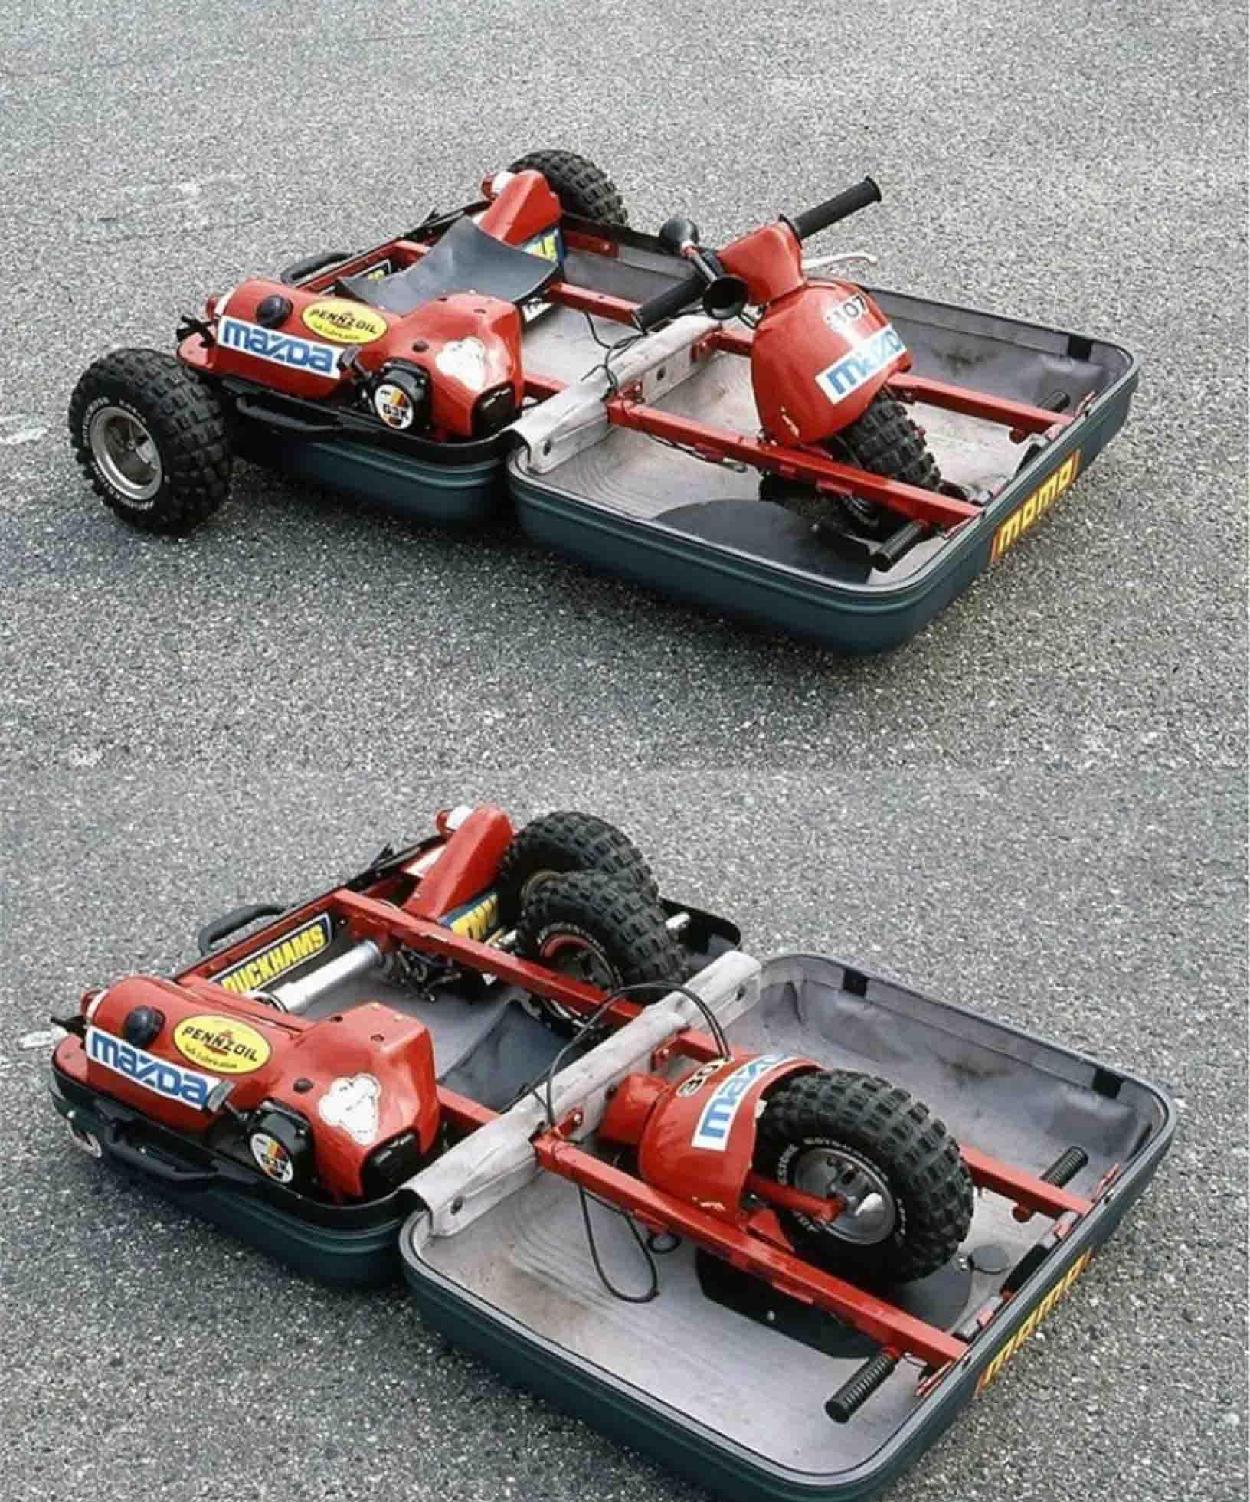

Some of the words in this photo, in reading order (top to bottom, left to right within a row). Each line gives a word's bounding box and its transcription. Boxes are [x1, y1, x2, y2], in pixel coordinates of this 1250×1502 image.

[309, 308, 377, 335] PENNZOIL
[224, 320, 333, 372] mazda
[182, 1026, 257, 1062] PENNZOIL
[92, 1032, 208, 1106] mazda
